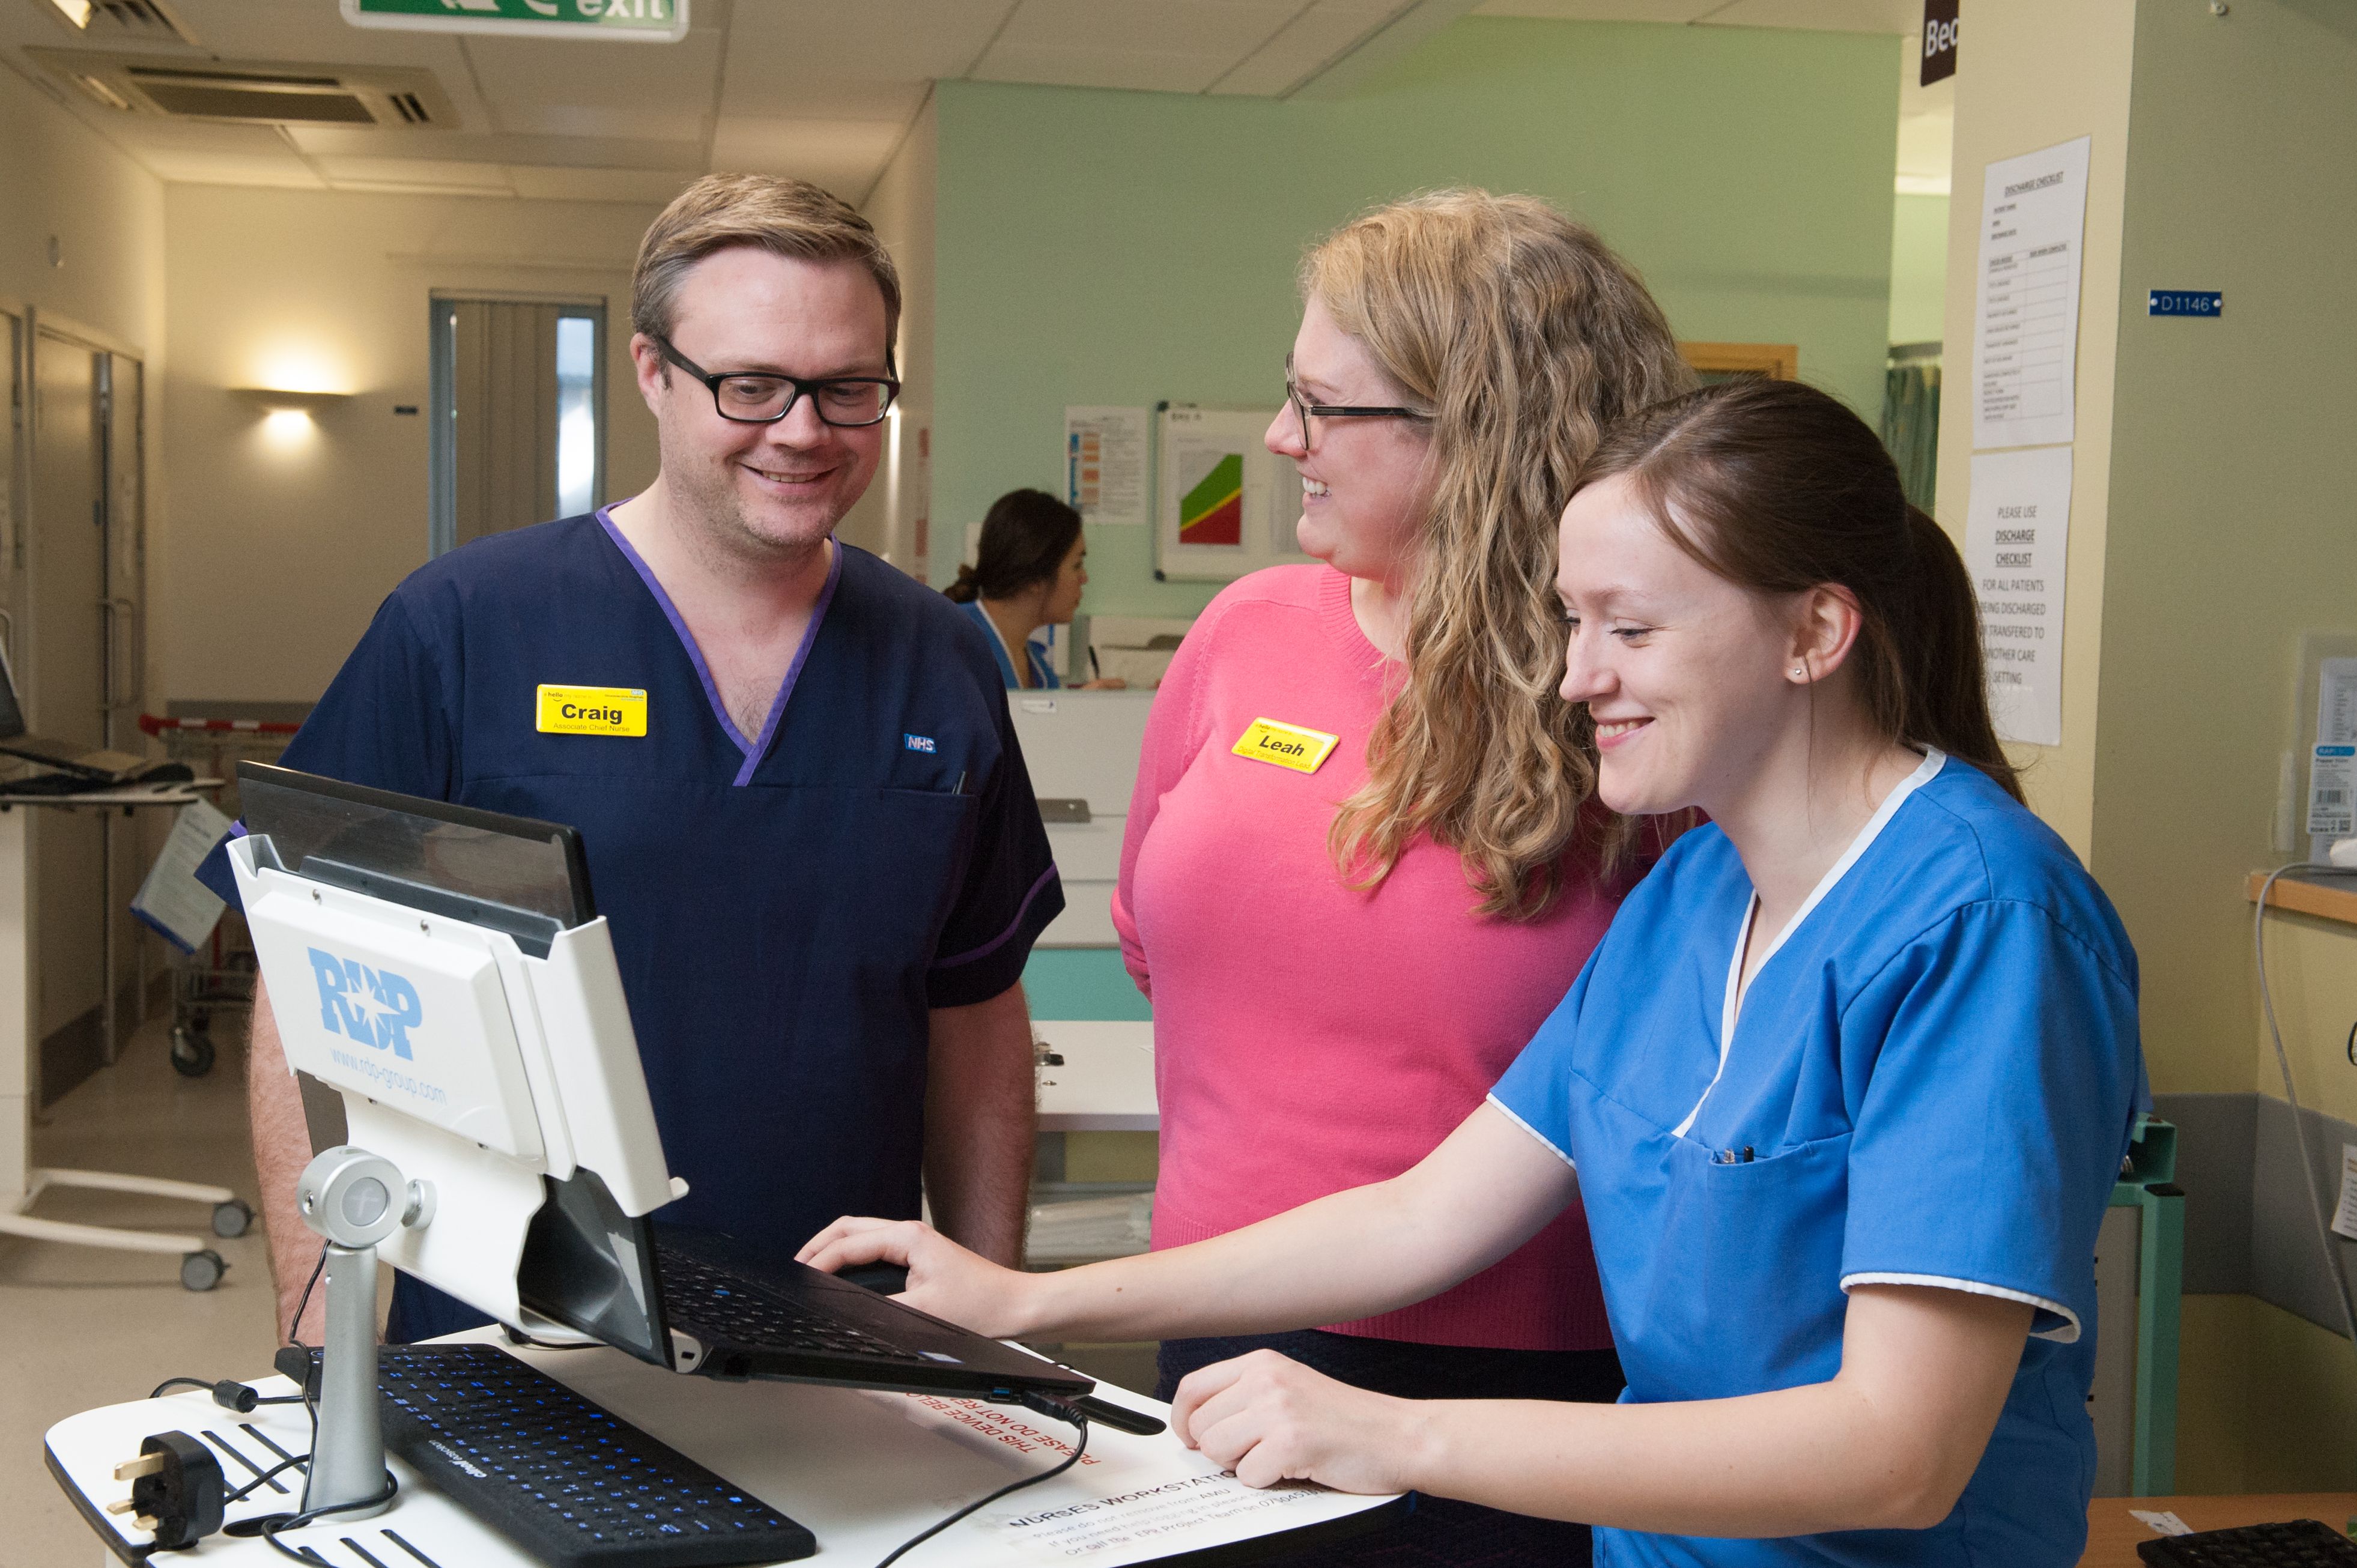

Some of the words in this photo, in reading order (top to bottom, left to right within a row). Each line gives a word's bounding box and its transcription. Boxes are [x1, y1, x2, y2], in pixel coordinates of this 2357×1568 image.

[2161, 295, 2210, 312] D1146
[1997, 506, 2022, 519] PLEASE
[2024, 505, 2037, 518] USE
[1995, 529, 2035, 543] DISCHARGE
[1995, 552, 2032, 566] CHECKLIST
[1983, 579, 1996, 590] FOR
[1997, 580, 2009, 592] ALL
[2012, 580, 2044, 592] PATIENTS
[2001, 602, 2046, 616] DISCHARGED
[561, 704, 622, 725] Craig
[553, 722, 587, 731] Associate
[908, 736, 935, 751] NHS
[1258, 735, 1305, 757] Leah
[307, 946, 423, 1061] RDP
[330, 1047, 447, 1106] www.rdp-group.com
[944, 1409, 1004, 1436] DEVICE
[975, 1409, 1016, 1424] NOT
[1010, 1424, 1039, 1436] DO
[998, 1435, 1038, 1453] THIS
[1032, 1435, 1102, 1465] PLEASE
[1009, 1503, 1100, 1527] NURSES
[1033, 1525, 1075, 1539] Please
[1078, 1520, 1094, 1529] do
[1097, 1515, 1117, 1525] not
[1120, 1502, 1166, 1517] remove
[1166, 1495, 1198, 1509] from
[1200, 1489, 1231, 1500] AMU
[1062, 1535, 1087, 1545] you
[1088, 1525, 1122, 1537] need
[1122, 1517, 1150, 1530] help
[1212, 1495, 1249, 1509] please
[1065, 1546, 1083, 1556] Or
[1085, 1541, 1108, 1551] call
[1108, 1534, 1132, 1543] the
[1134, 1528, 1159, 1538] EPR
[1160, 1517, 1209, 1532] Project
[1207, 1507, 1242, 1520] Team
